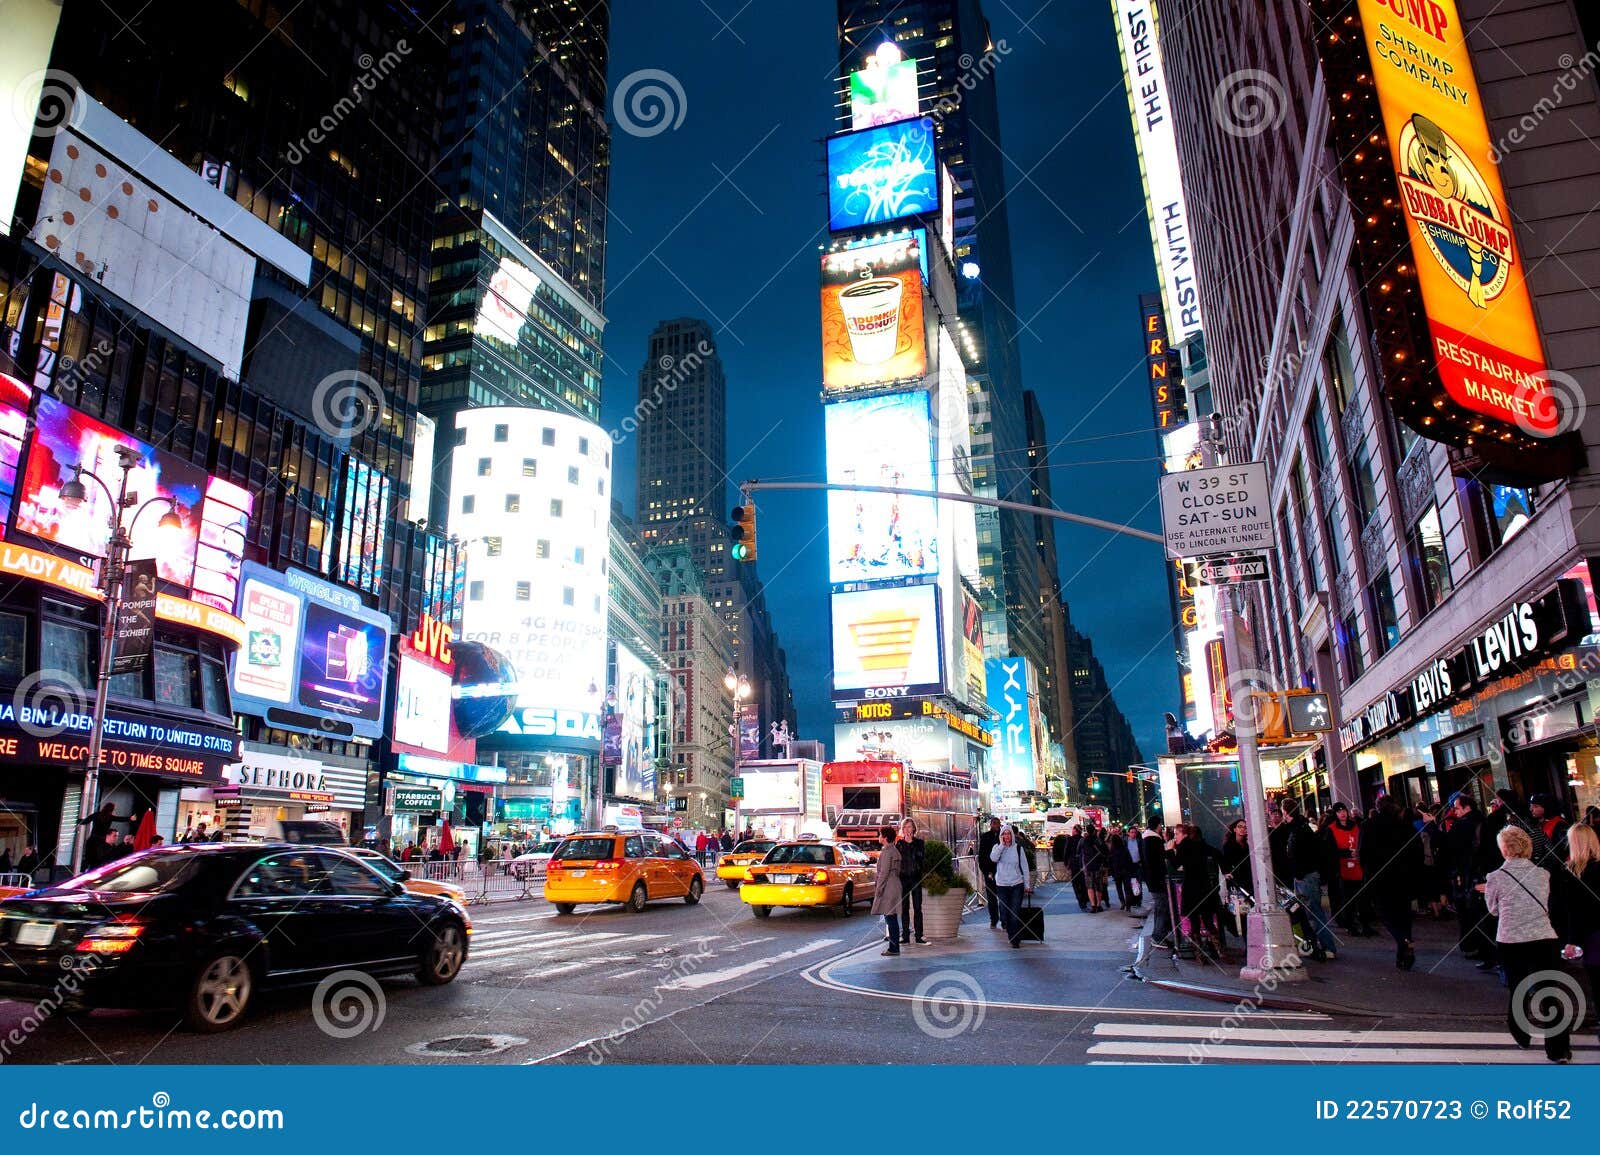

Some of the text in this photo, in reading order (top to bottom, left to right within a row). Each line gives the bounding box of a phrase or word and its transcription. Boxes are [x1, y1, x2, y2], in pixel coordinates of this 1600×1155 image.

[1376, 0, 1449, 44] UMP
[1379, 23, 1454, 76] SHRIMP
[1129, 5, 1163, 132] THE FIRST
[1375, 40, 1468, 105] COMPANY
[1402, 181, 1510, 256] BUBBA GUMP
[1162, 201, 1188, 272] WITH
[1428, 224, 1467, 248] SHRIMP
[858, 314, 898, 331] DONUTS
[1146, 315, 1170, 428] ERNST
[1436, 337, 1546, 394] RESTAURANT
[1463, 377, 1535, 419] MARKET
[1178, 473, 1248, 493] W 39 ST
[1182, 490, 1249, 509] CLOSED
[1178, 506, 1257, 526] SAT-SUN
[1168, 521, 1270, 541] USE ALTERNATE ROUTE
[1175, 533, 1266, 550] TO LINCOLN TUNNEL
[3, 548, 57, 578] LADY
[1200, 562, 1259, 579] ONE WAY
[287, 571, 360, 613] WRIGLEY'S
[119, 627, 151, 638] EXHIBIT
[121, 615, 138, 624] THE
[414, 613, 453, 665] JVC
[864, 686, 910, 698] SONY
[20, 707, 48, 724] BIN
[102, 718, 148, 738] RETURN
[150, 726, 165, 741] TO
[166, 730, 202, 747] UNITED
[203, 735, 233, 753] STATES
[894, 723, 934, 739] Optima
[38, 742, 107, 764] WELCOE
[111, 750, 127, 766] TO
[130, 752, 163, 770] TIMES
[165, 757, 204, 775] SQUARE
[240, 764, 328, 792] SEPHORA
[396, 792, 441, 801] STARBUCKS
[404, 799, 433, 807] COFFEE
